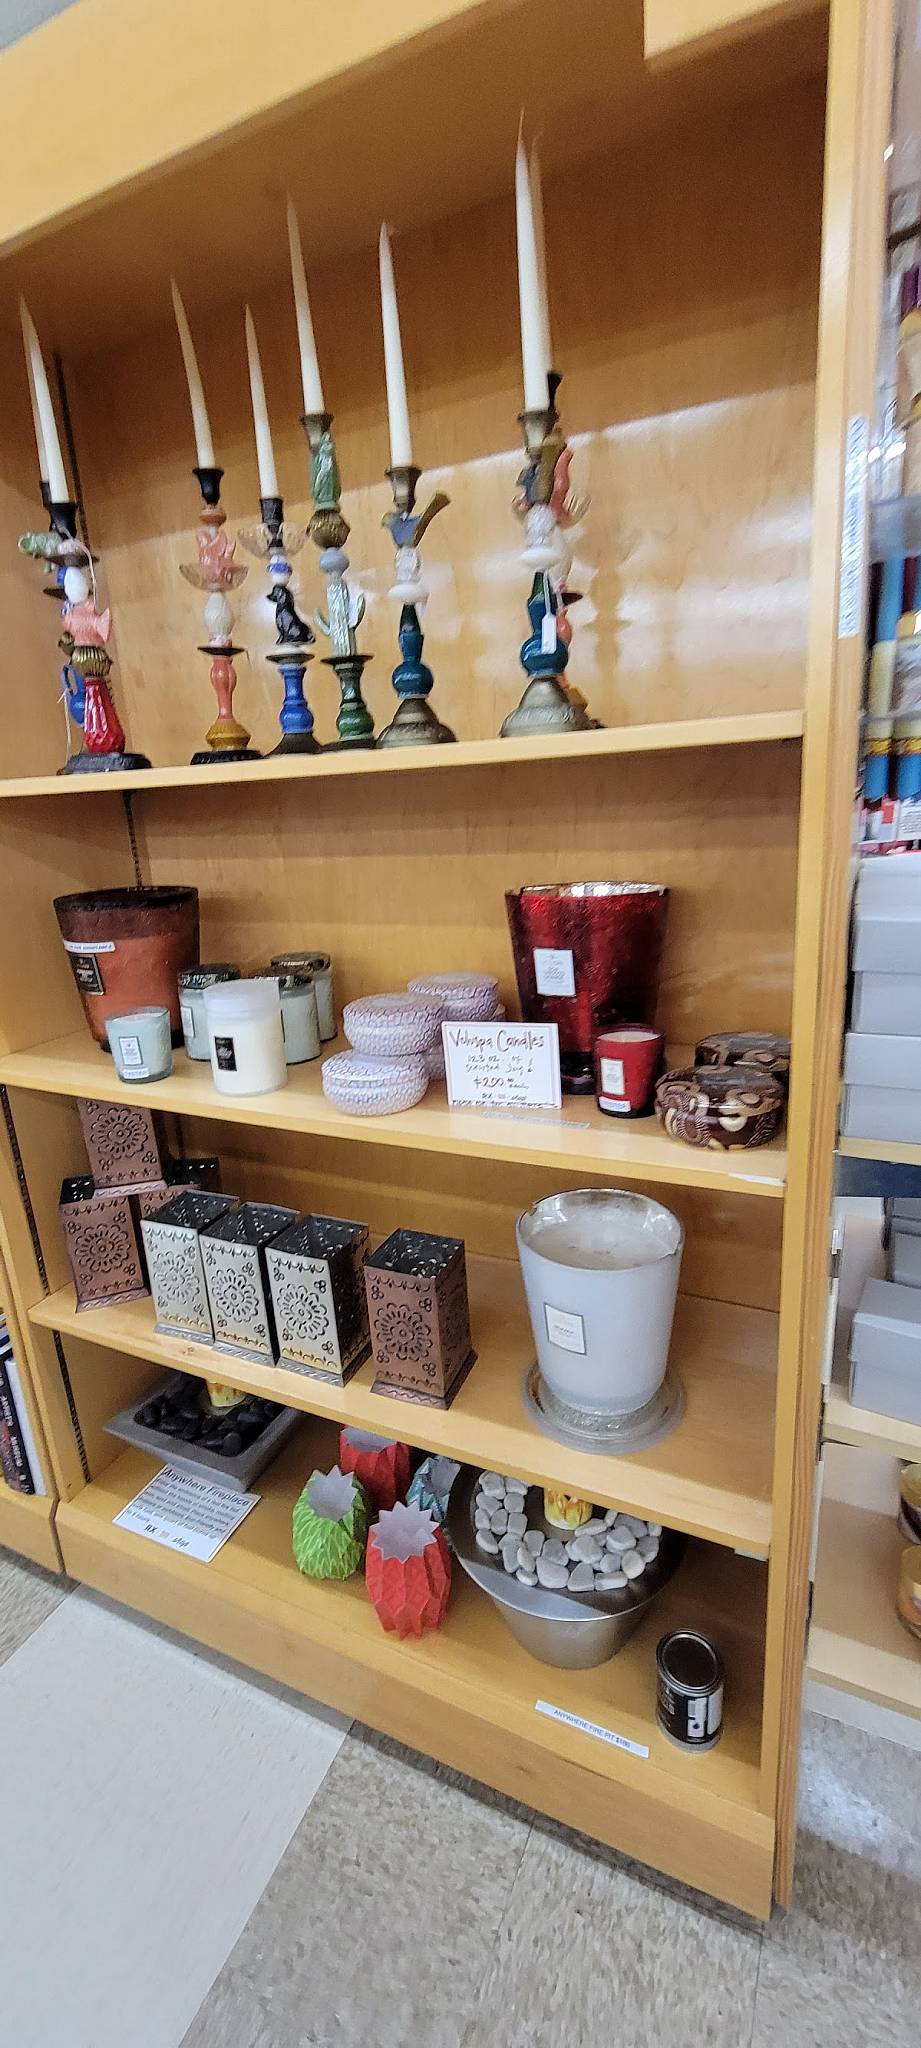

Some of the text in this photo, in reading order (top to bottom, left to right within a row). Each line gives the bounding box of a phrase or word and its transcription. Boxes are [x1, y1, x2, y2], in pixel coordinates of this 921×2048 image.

[497, 1029, 545, 1053] Candles
[164, 1469, 249, 1506] Anywhere Fireplace
[554, 1709, 587, 1728] ANYWHERE
[589, 1725, 604, 1736] FIRE
[604, 1731, 616, 1741] PIT
